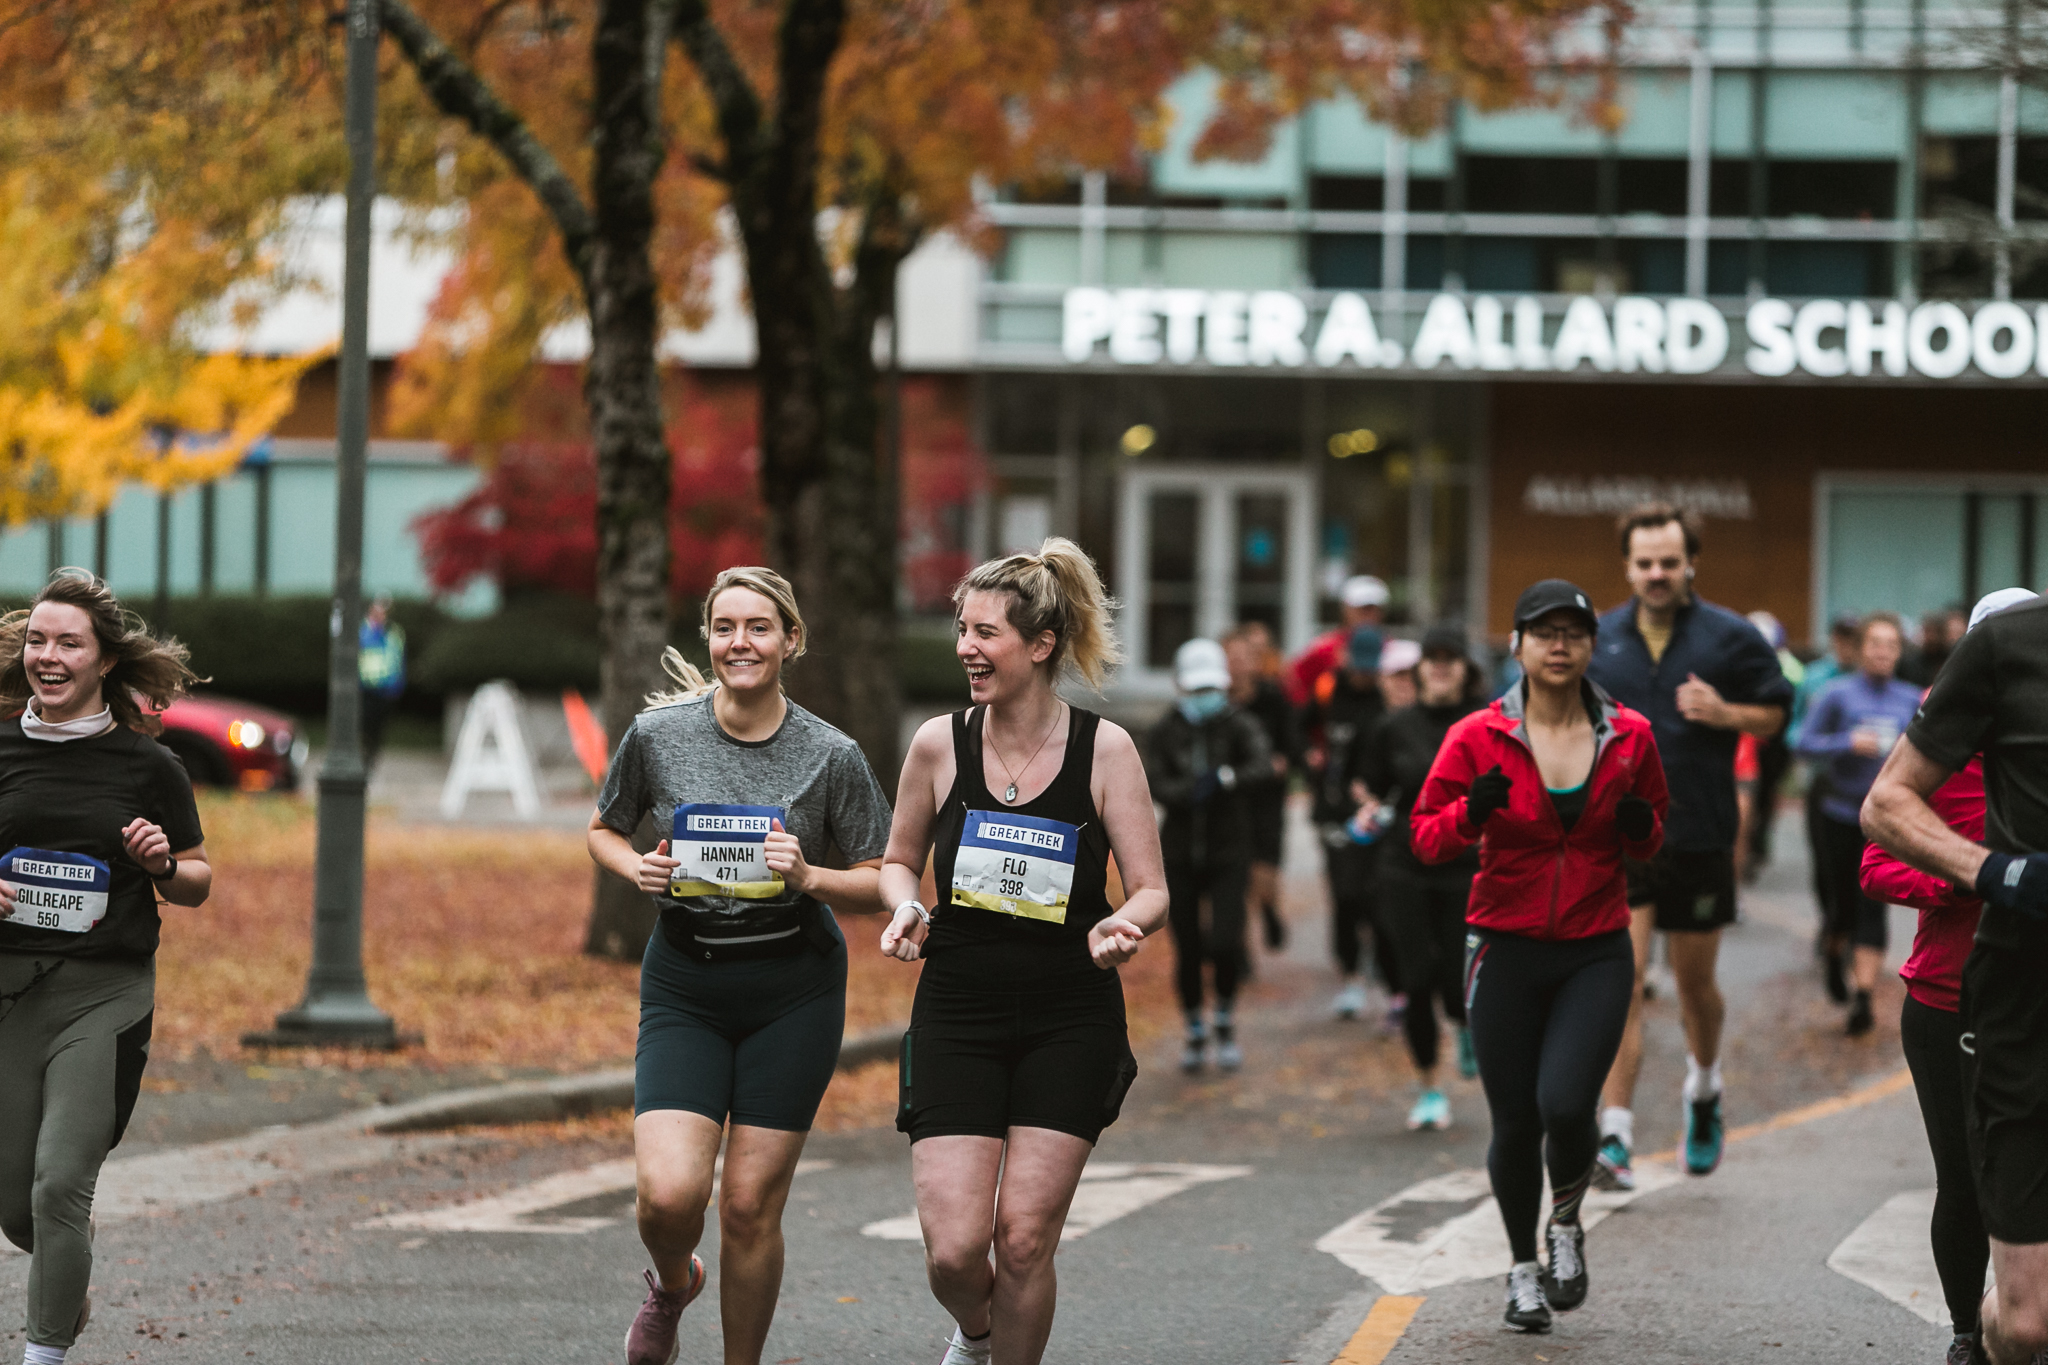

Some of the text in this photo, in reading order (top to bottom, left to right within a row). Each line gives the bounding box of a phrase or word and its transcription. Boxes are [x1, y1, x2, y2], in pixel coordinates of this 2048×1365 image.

[1062, 288, 1307, 366] PETER
[1314, 290, 1402, 370] A.
[1412, 293, 1729, 374] ALLARD
[697, 818, 767, 830] GREAT TREK
[989, 826, 1061, 848] GREAT TREK
[701, 847, 754, 862] HANNAH
[22, 862, 92, 879] GREAT TREK
[716, 867, 738, 880] 471
[1002, 857, 1027, 876] FLO
[999, 879, 1024, 896] 398
[17, 888, 84, 911] GILLREAPE
[37, 911, 60, 927] 550
